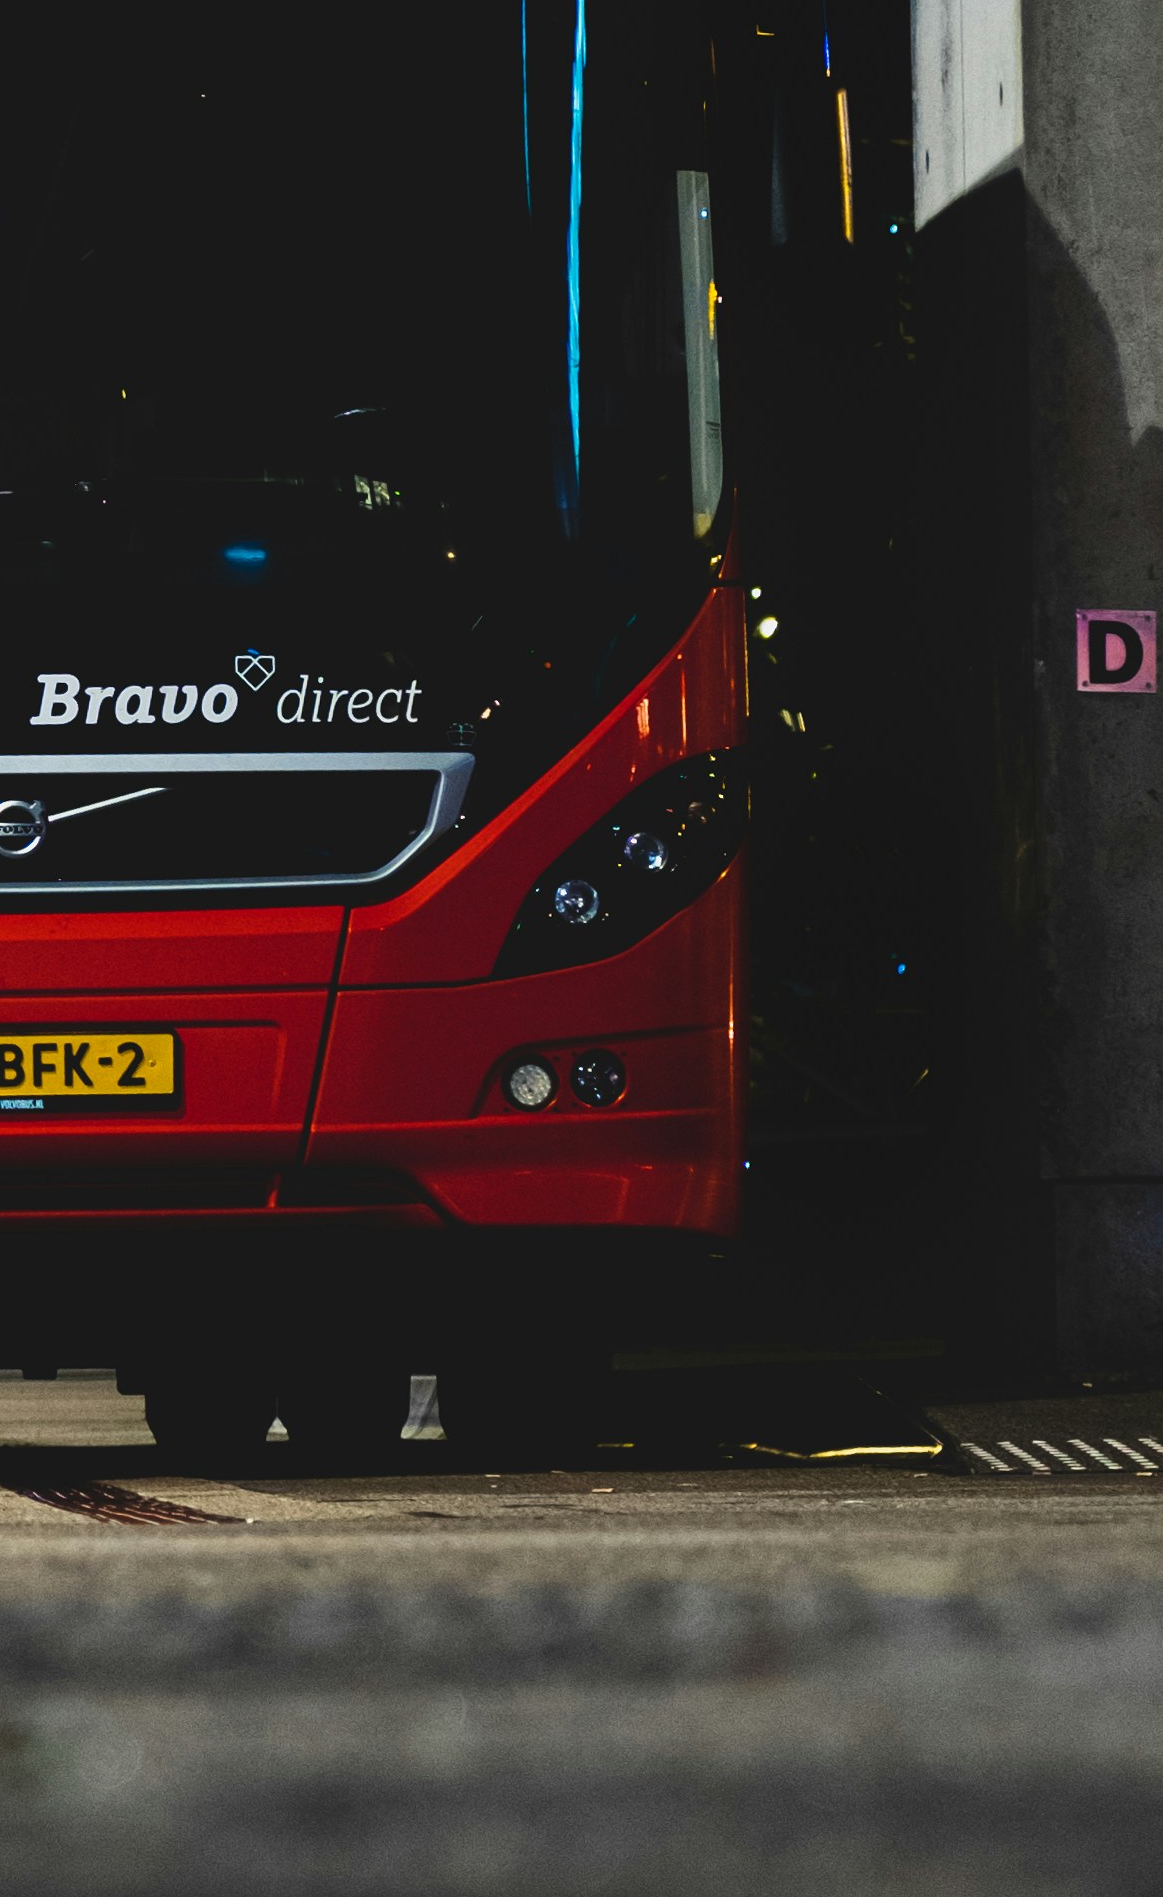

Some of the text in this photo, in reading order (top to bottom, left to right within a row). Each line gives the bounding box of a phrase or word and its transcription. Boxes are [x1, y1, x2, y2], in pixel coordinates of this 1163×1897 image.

[1088, 620, 1144, 685] D
[30, 673, 422, 725] Bravo direct
